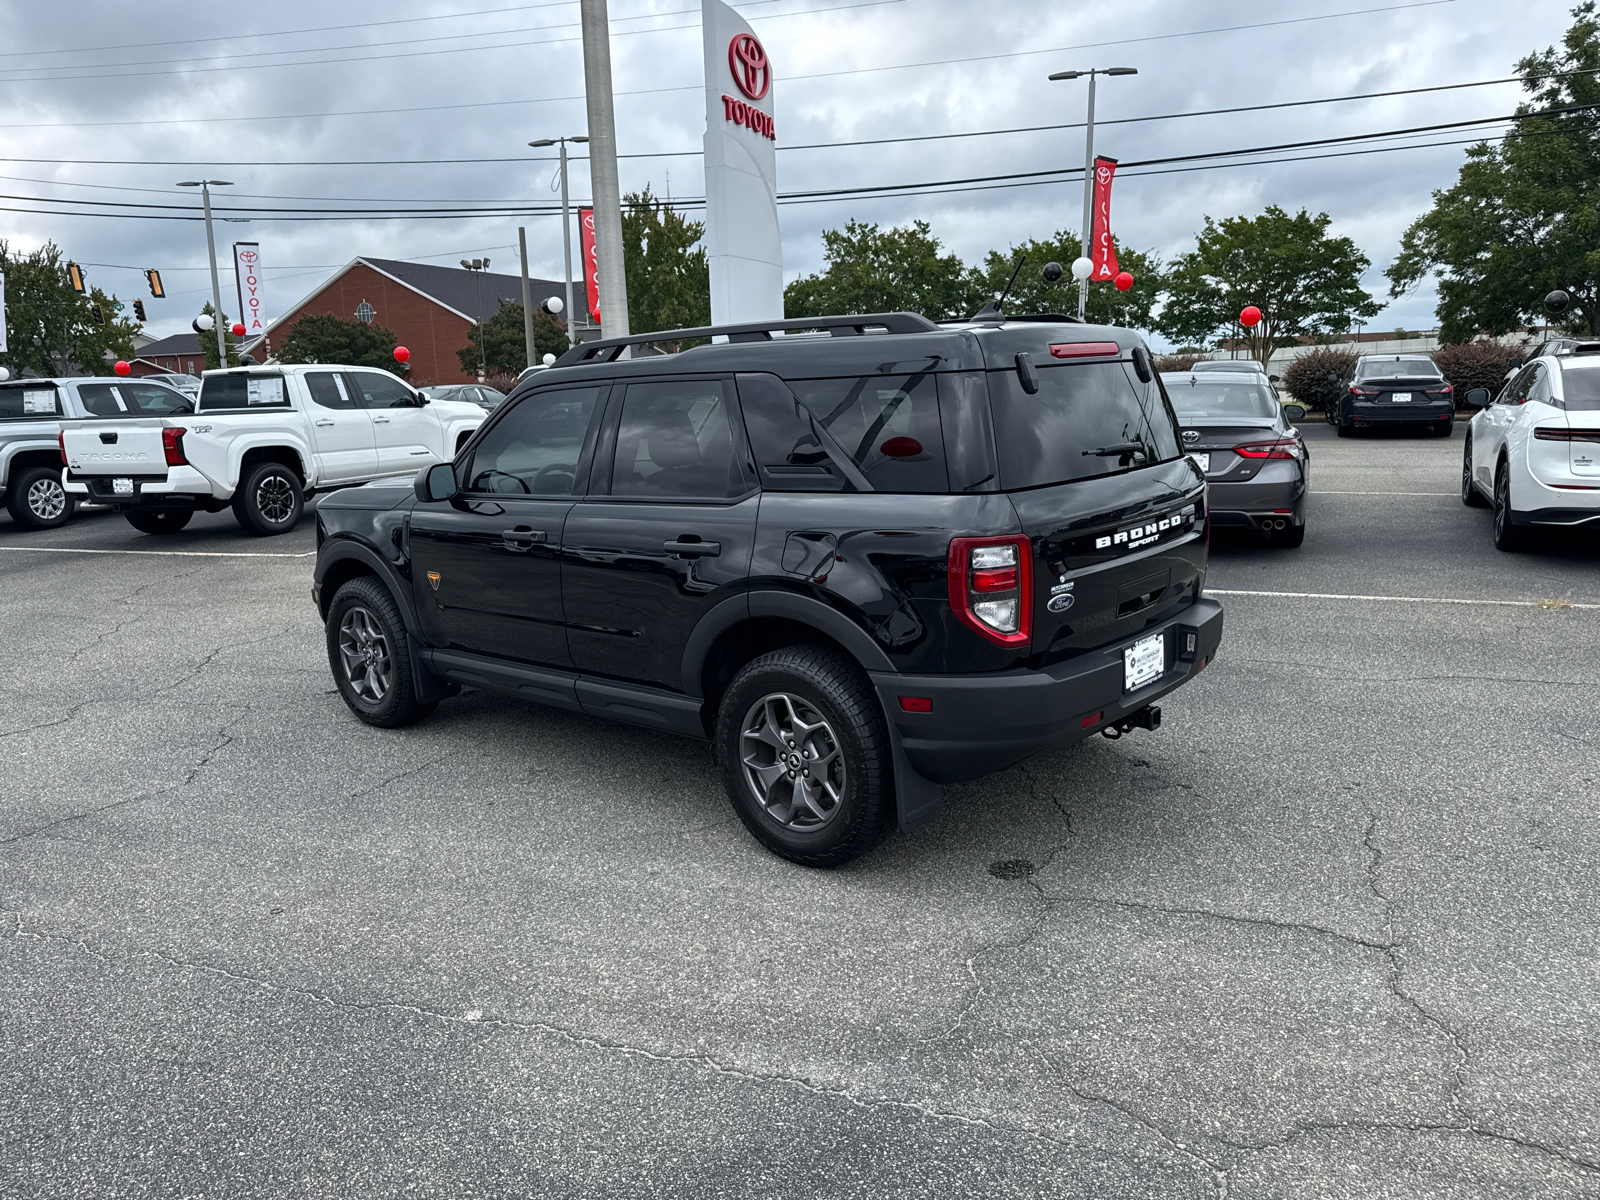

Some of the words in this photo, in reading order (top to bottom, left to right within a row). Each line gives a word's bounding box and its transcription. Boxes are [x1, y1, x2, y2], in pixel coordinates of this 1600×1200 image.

[721, 95, 776, 141] TOYOTA
[246, 264, 262, 329] TOYOTA
[80, 452, 148, 461] TACOMA
[1095, 514, 1182, 549] BRONCO
[1128, 534, 1160, 549] SPORT
